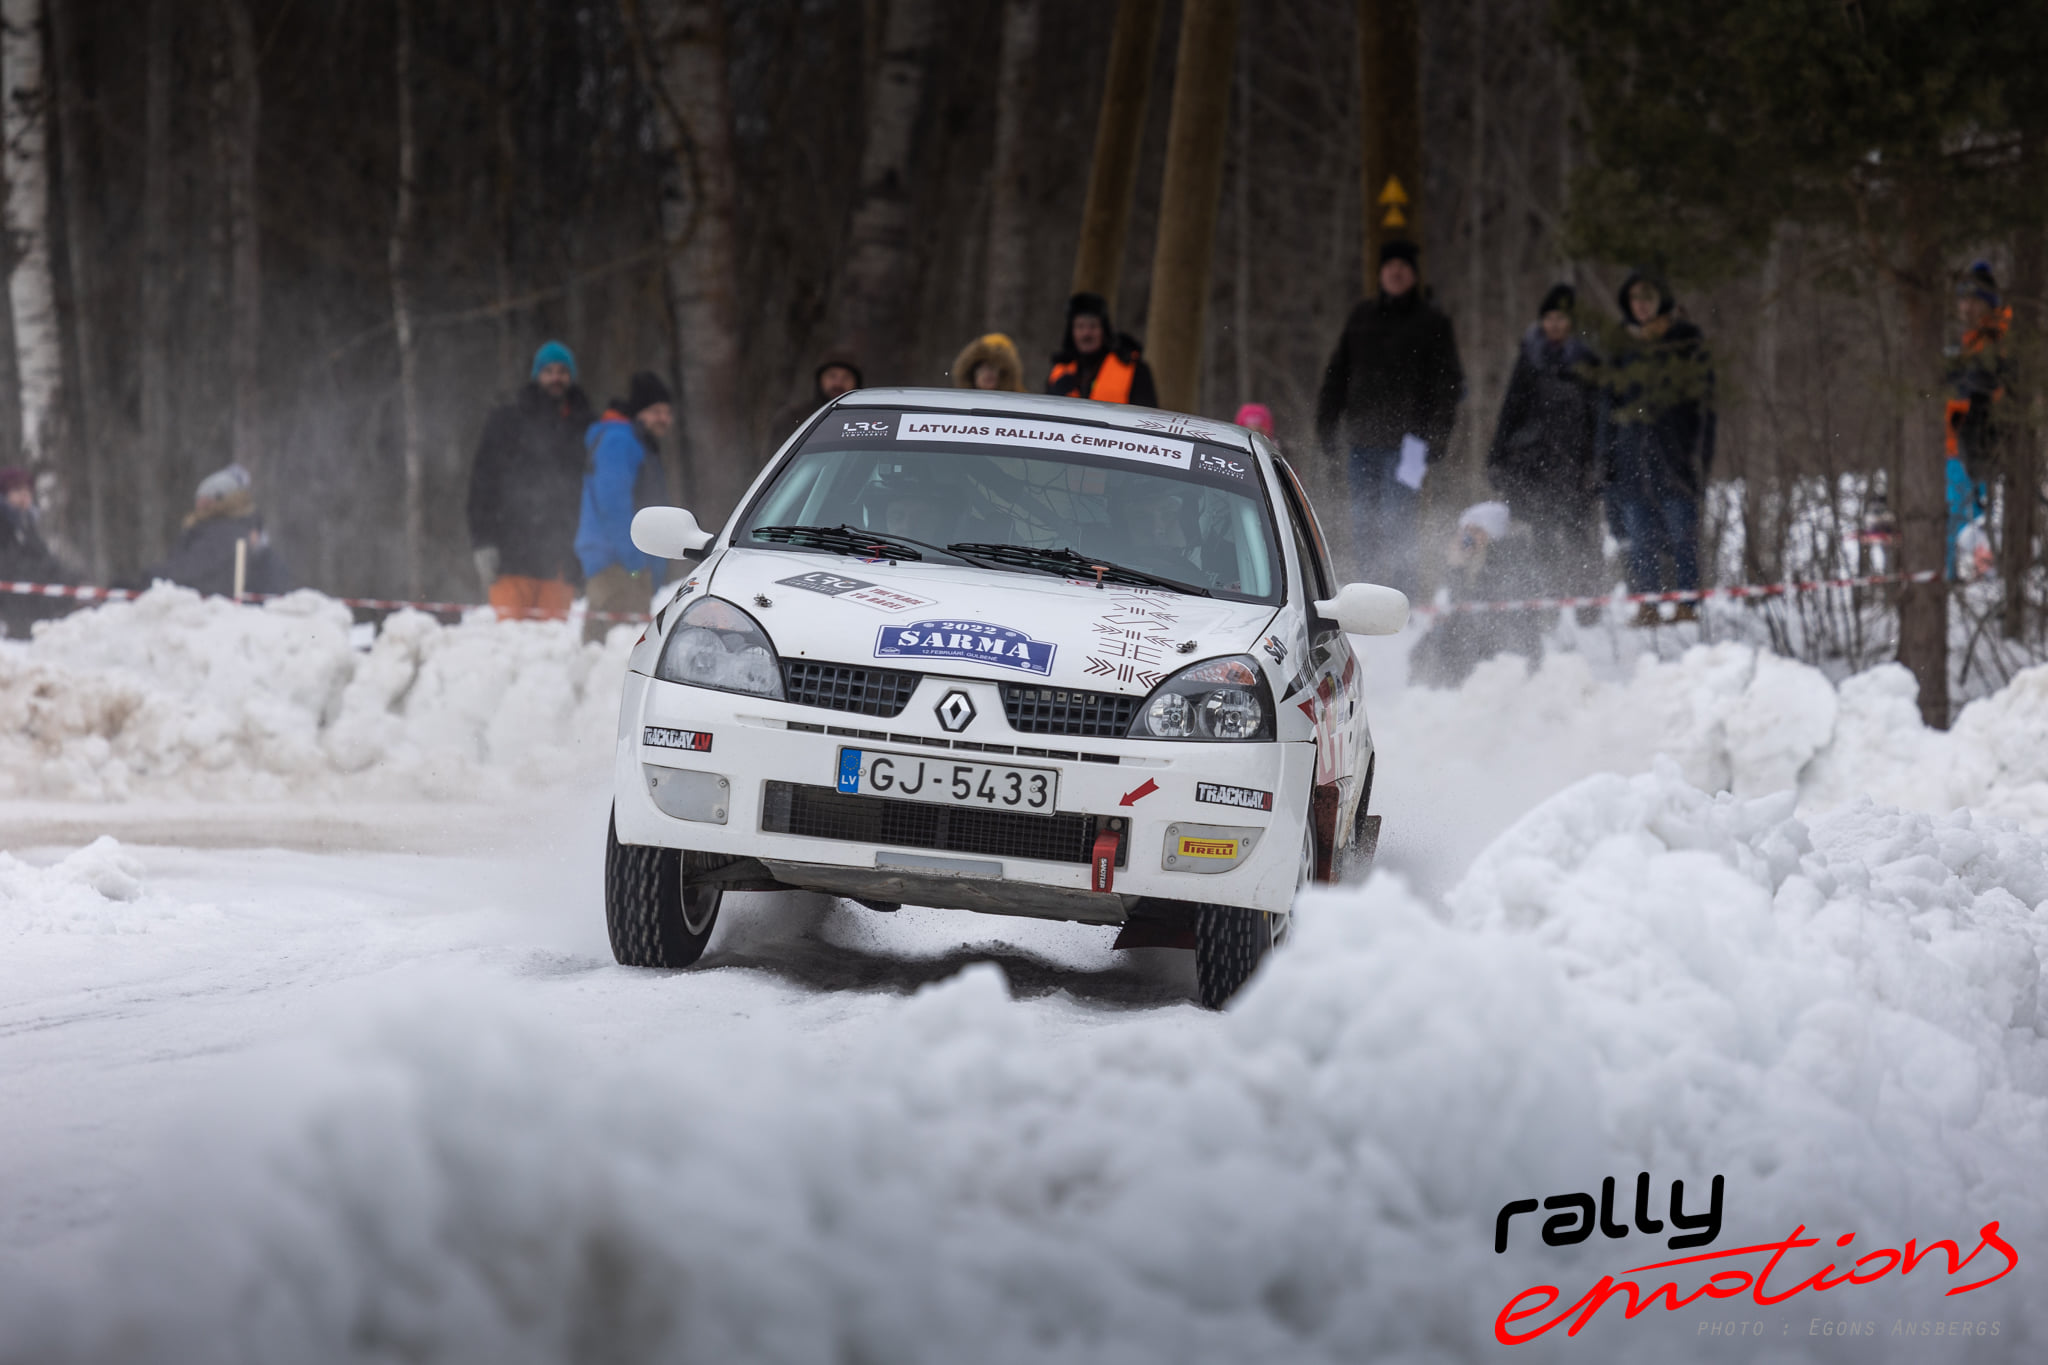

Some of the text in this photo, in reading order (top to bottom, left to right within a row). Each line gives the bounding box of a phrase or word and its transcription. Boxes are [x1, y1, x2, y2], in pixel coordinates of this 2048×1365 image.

[908, 423, 1183, 460] LATVIJAS RALLIJA ČEMPIONĀTS
[941, 621, 997, 635] 2022
[897, 630, 1031, 660] SARMA
[841, 757, 1048, 808] LV GJ-5433
[1183, 840, 1234, 856] PIRELLI
